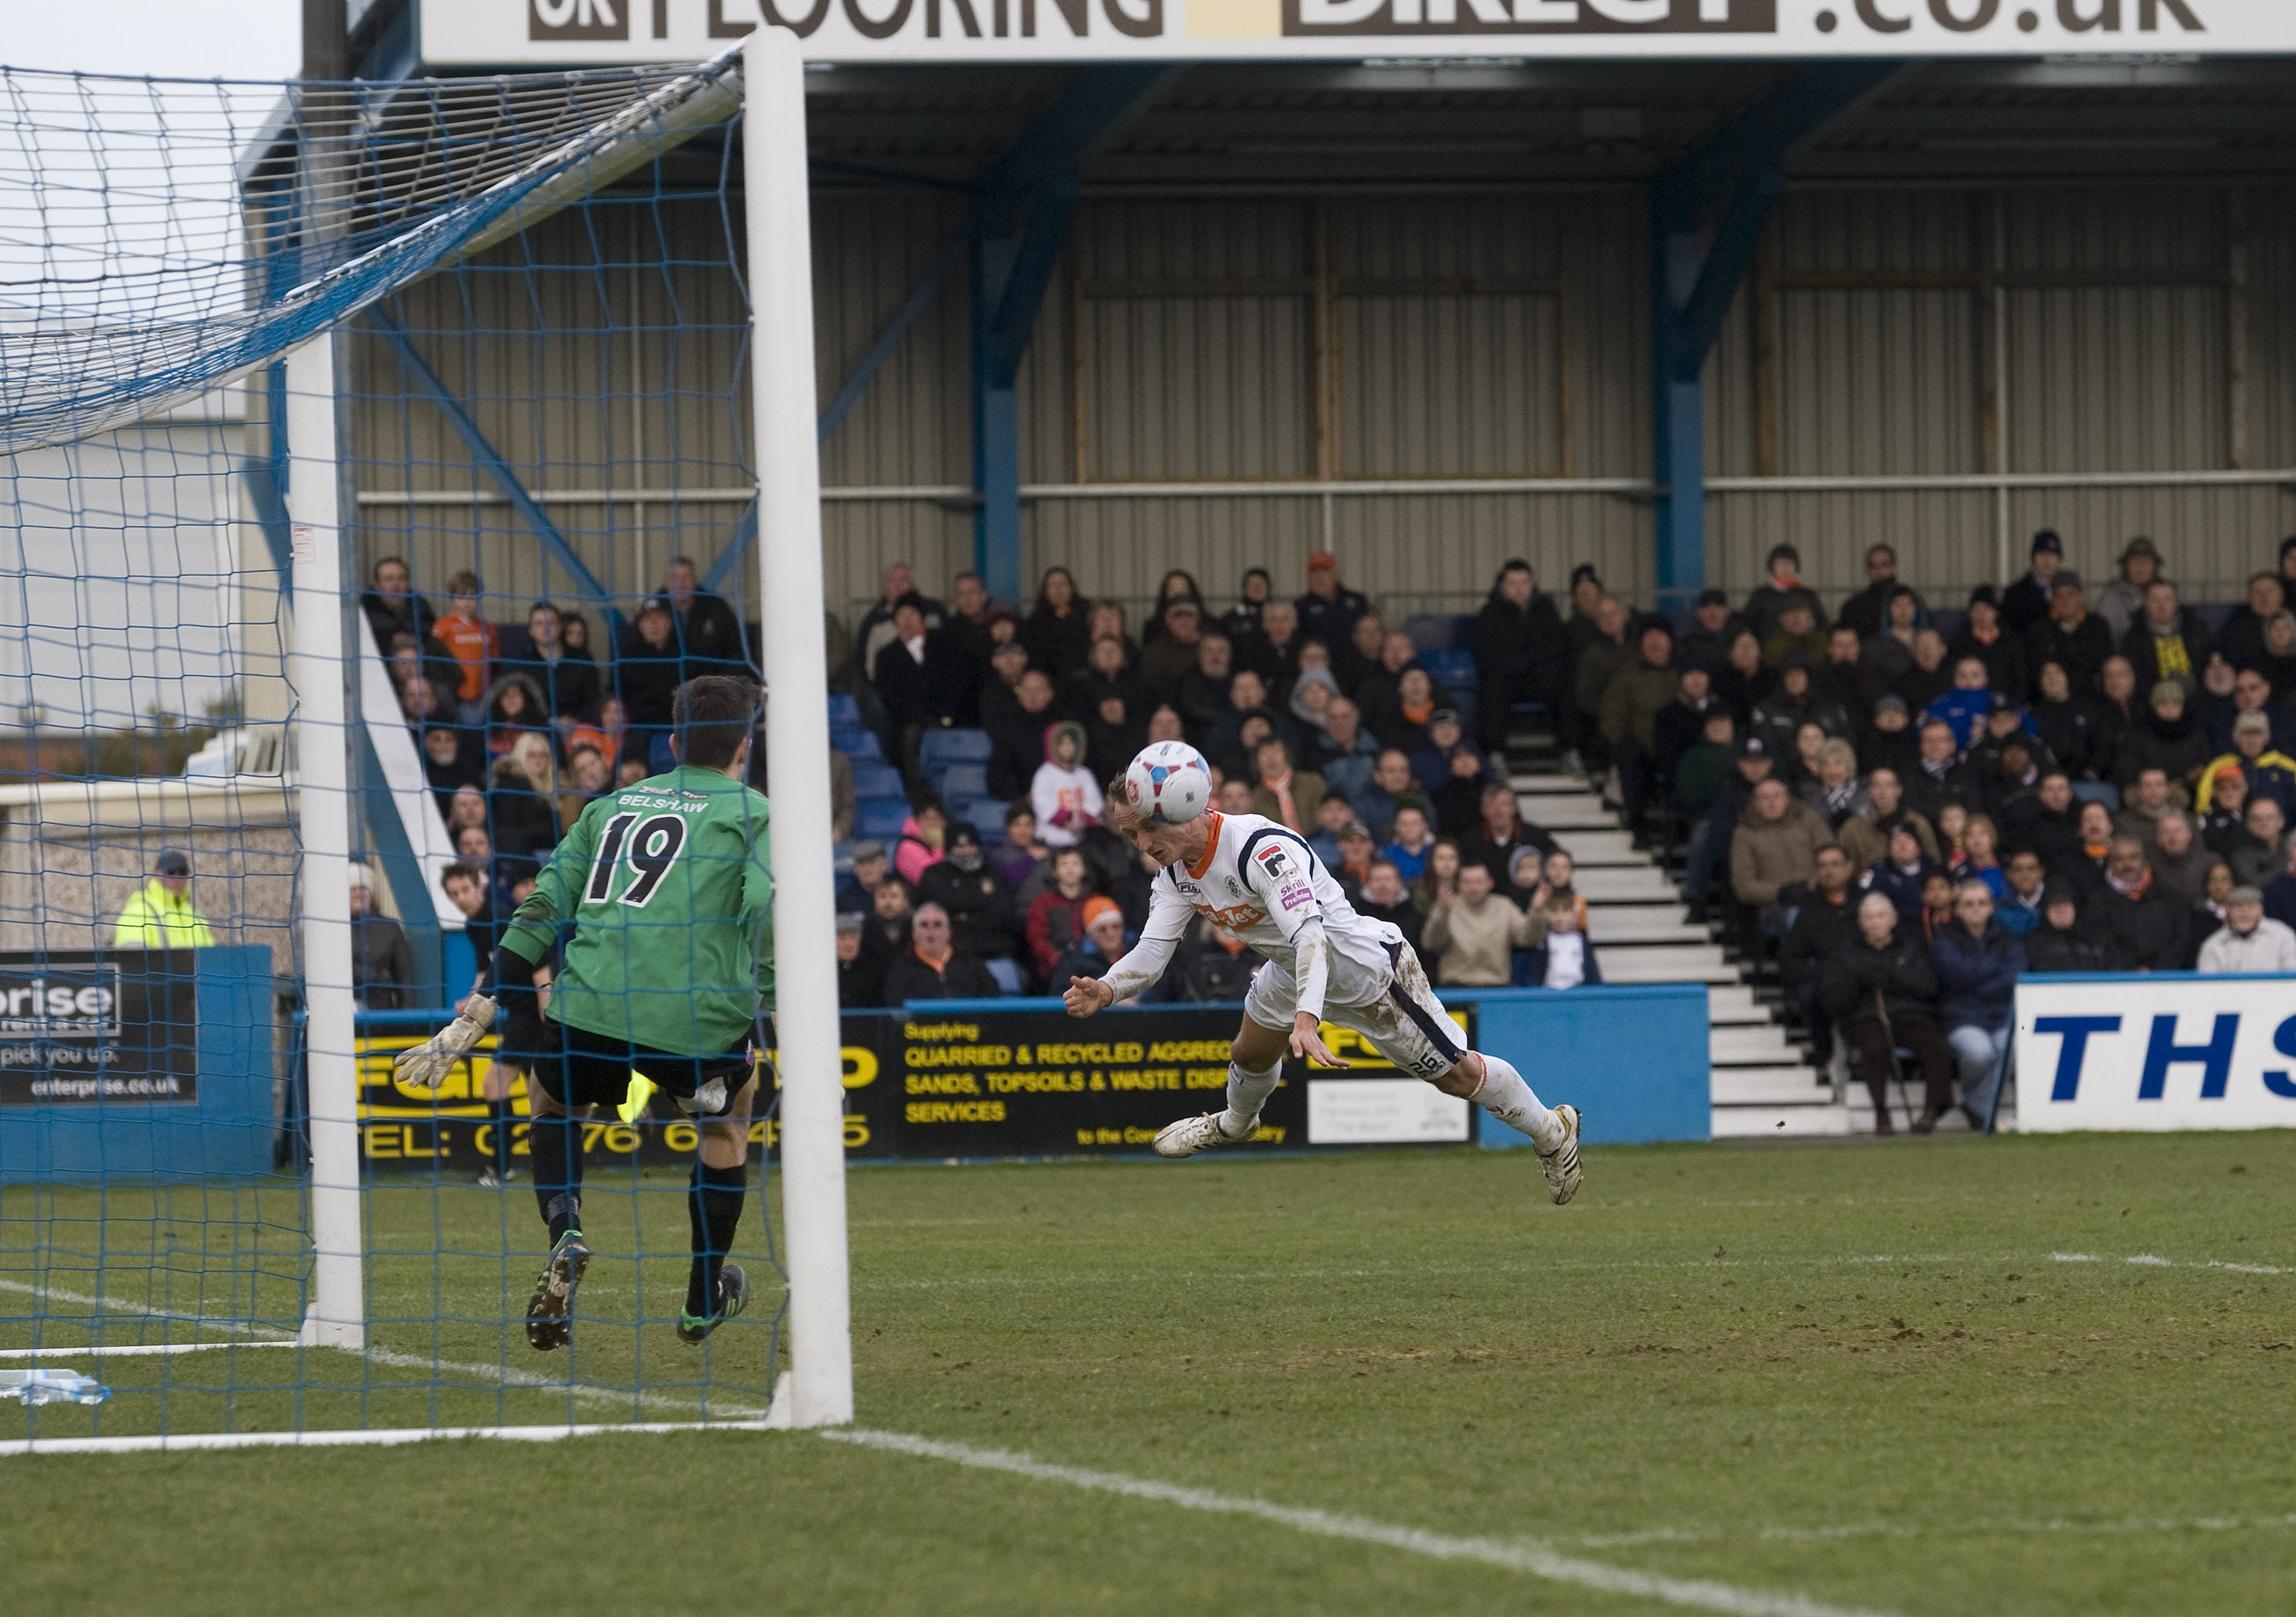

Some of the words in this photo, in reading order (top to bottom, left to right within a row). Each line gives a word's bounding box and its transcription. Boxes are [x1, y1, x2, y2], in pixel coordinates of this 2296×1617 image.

[618, 794, 709, 813] BELSHAW
[584, 812, 688, 908] 19
[903, 1022, 980, 1042] Supplying
[904, 1044, 1012, 1067] QUARRIED
[1016, 1044, 1033, 1065] &
[1037, 1042, 1144, 1065] RECYCLED
[905, 1073, 981, 1095] SANDS,
[984, 1070, 1085, 1092] TOPSOILS
[1089, 1070, 1106, 1091] &
[1109, 1069, 1181, 1090] WASTE
[905, 1100, 1007, 1123] SERVICES
[356, 1124, 451, 1158] EL:
